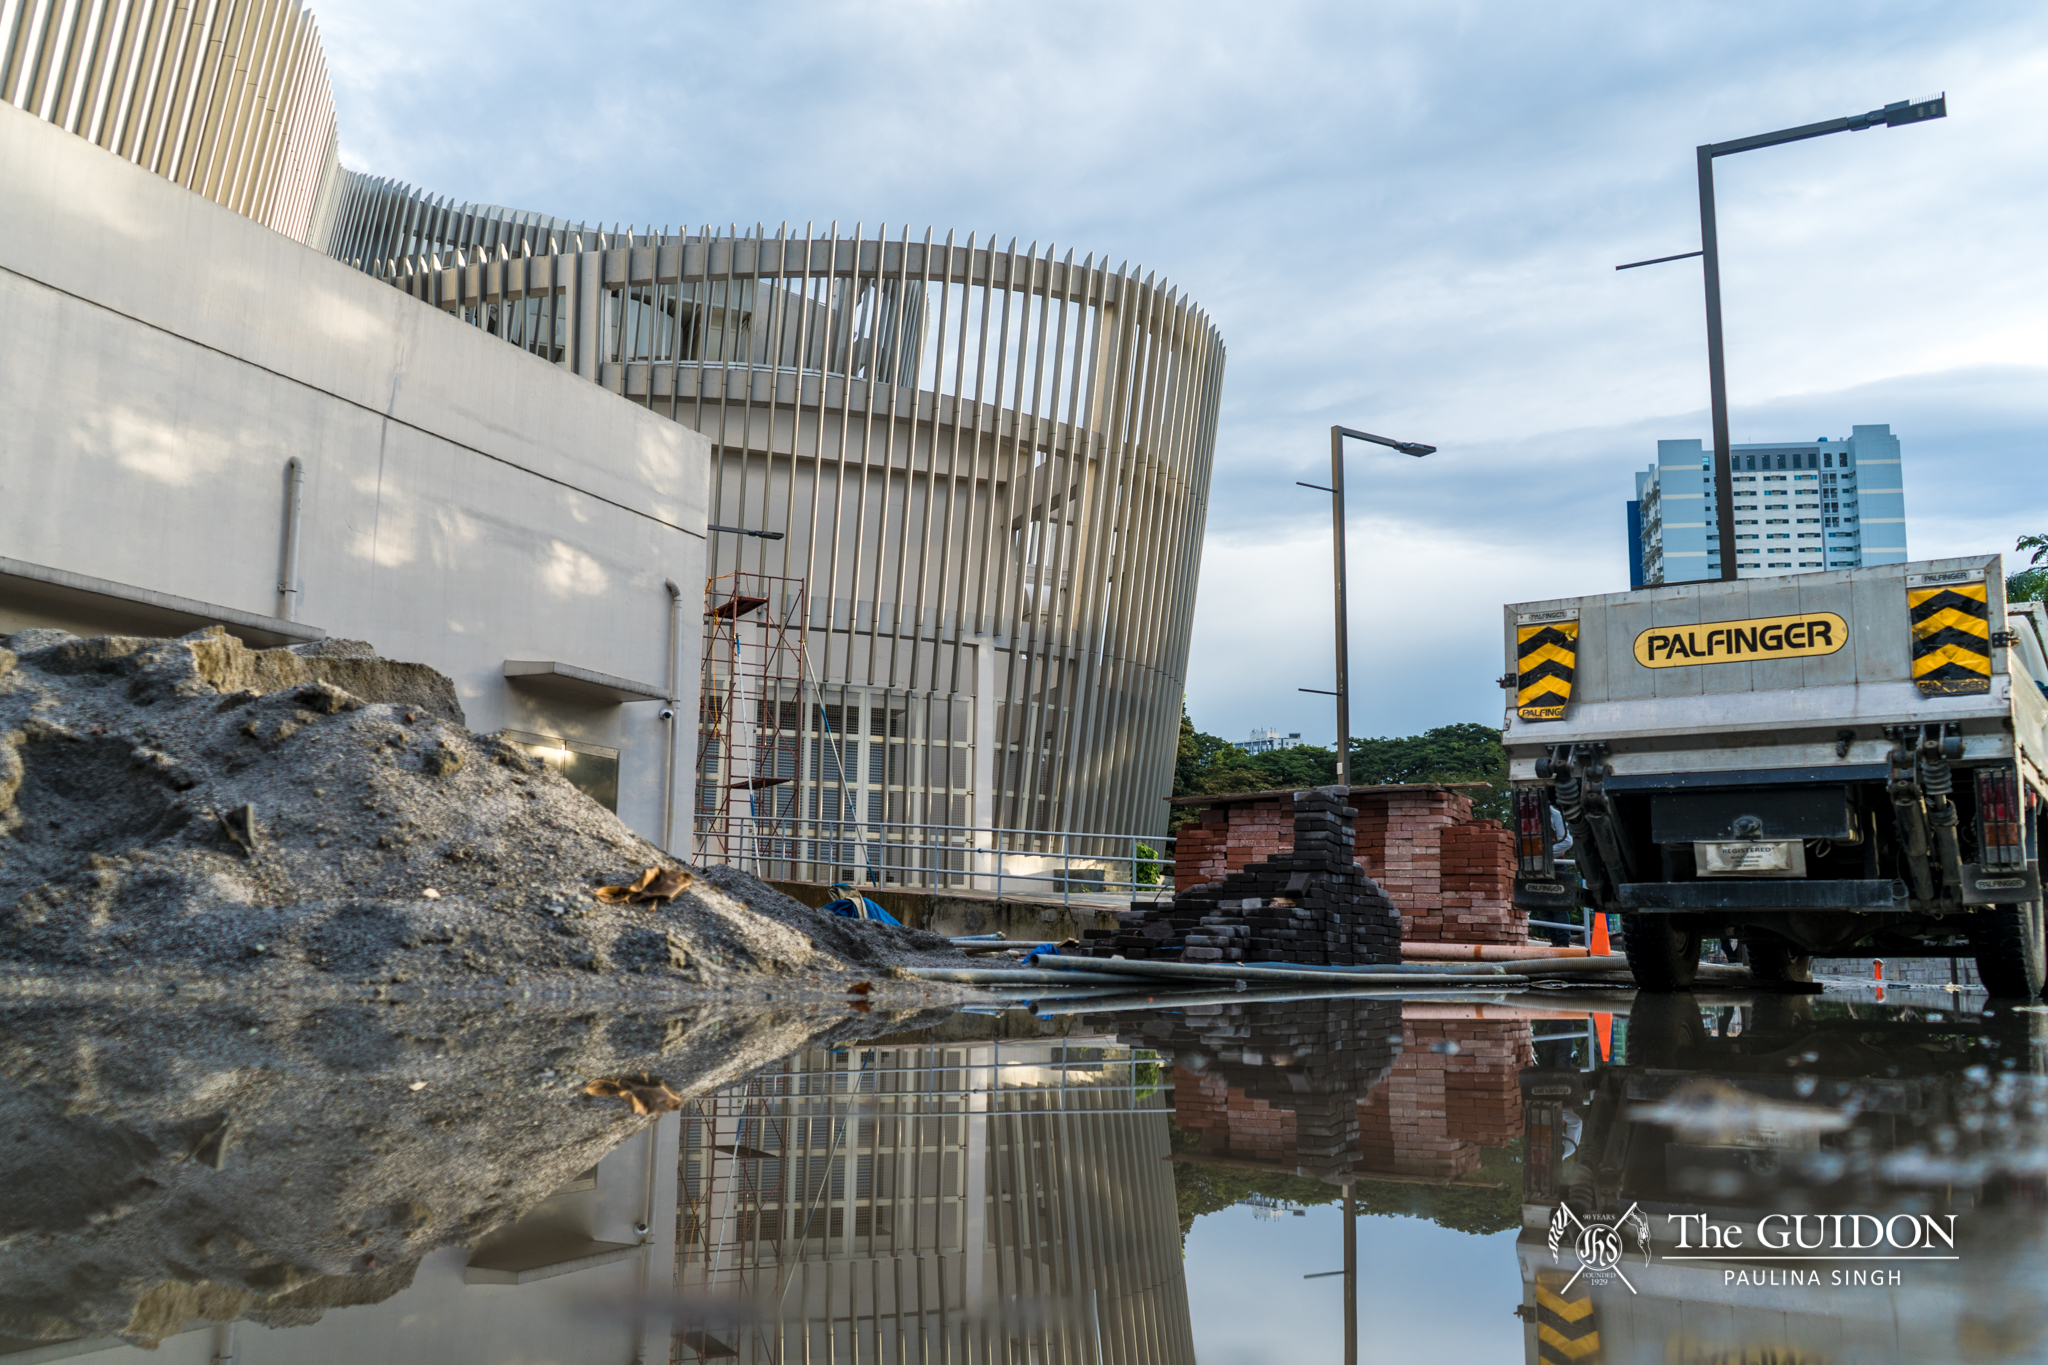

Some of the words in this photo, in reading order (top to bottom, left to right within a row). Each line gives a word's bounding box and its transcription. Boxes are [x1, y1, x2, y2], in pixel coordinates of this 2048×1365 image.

[1924, 572, 1967, 582] PALFINGER
[1531, 612, 1565, 621] PALFINGER
[1647, 620, 1833, 661] PALFINGER
[1527, 884, 1563, 893] PALFINGER
[1978, 880, 2023, 888] PALFINGER
